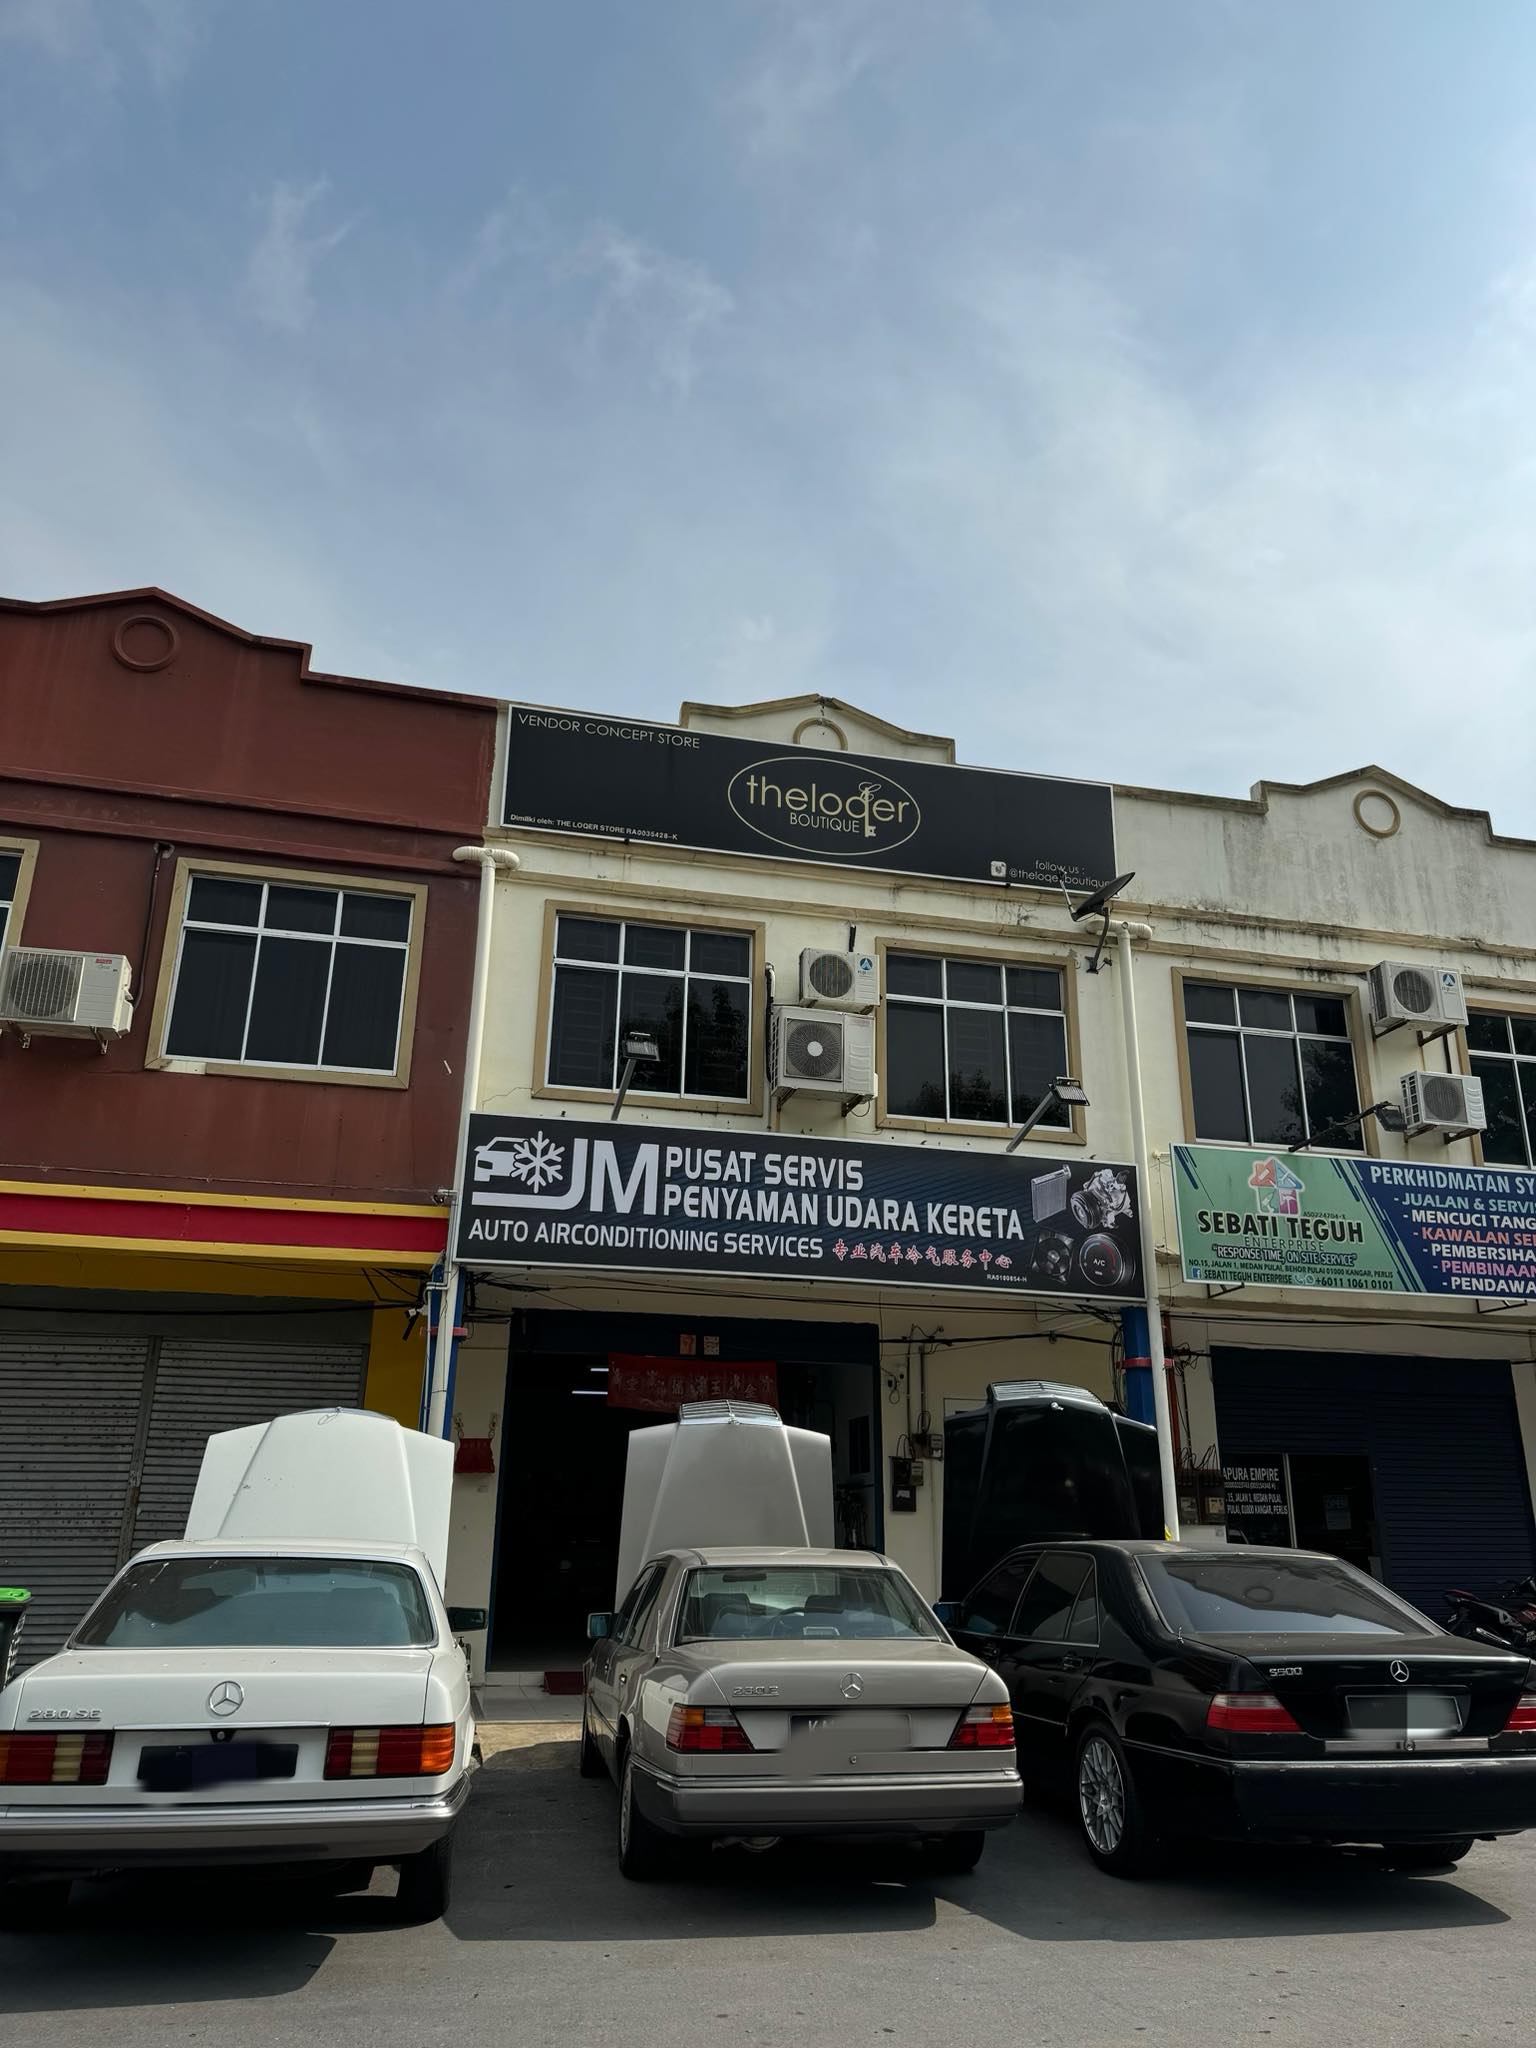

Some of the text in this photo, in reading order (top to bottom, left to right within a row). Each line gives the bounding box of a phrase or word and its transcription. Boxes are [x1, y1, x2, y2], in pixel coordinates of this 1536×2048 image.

[518, 712, 700, 749] VENDOR CONCEPT STORE
[556, 819, 571, 828] THE
[600, 824, 625, 833] STORE
[790, 812, 860, 833] BOUTIQUE
[1035, 860, 1065, 872] follow
[1069, 866, 1079, 874] us
[665, 1146, 863, 1191] PUSAT SERVIS
[1370, 1165, 1510, 1193] PERKHIDMATAN
[664, 1184, 1025, 1240] PENYAMAN UDARA KERETA
[1402, 1193, 1536, 1214] JUALAN & SERVI
[1197, 1210, 1364, 1243] SEBATI TEGUH
[1411, 1209, 1536, 1230] MENCUCI TANG
[468, 1218, 823, 1259] AUTO AIRCONDITIONING SERVICES
[1244, 1236, 1324, 1251] ENTERPRISE
[1422, 1227, 1510, 1245] KAWALAN
[832, 1238, 1013, 1271] 专业汽车冷气服务中心
[1287, 1251, 1299, 1263] ON
[1302, 1252, 1318, 1264] SITE
[1431, 1243, 1536, 1262] PEMBERSIHA
[1093, 1258, 1106, 1267] A/C
[1211, 1260, 1232, 1269] JALAN
[1241, 1262, 1263, 1270] MEDAN
[1307, 1267, 1325, 1275] PULAI
[1326, 1267, 1344, 1276] 01000
[1374, 1270, 1394, 1278] PERLIS
[1204, 1269, 1393, 1290] SEBATI TEGUH ENTERPRISE +6011 1061 0101
[1451, 1276, 1536, 1294] PENDAWA
[1250, 1467, 1279, 1482] EMPIRE
[1269, 1666, 1303, 1677] S500
[28, 1708, 102, 1720] 280 SE
